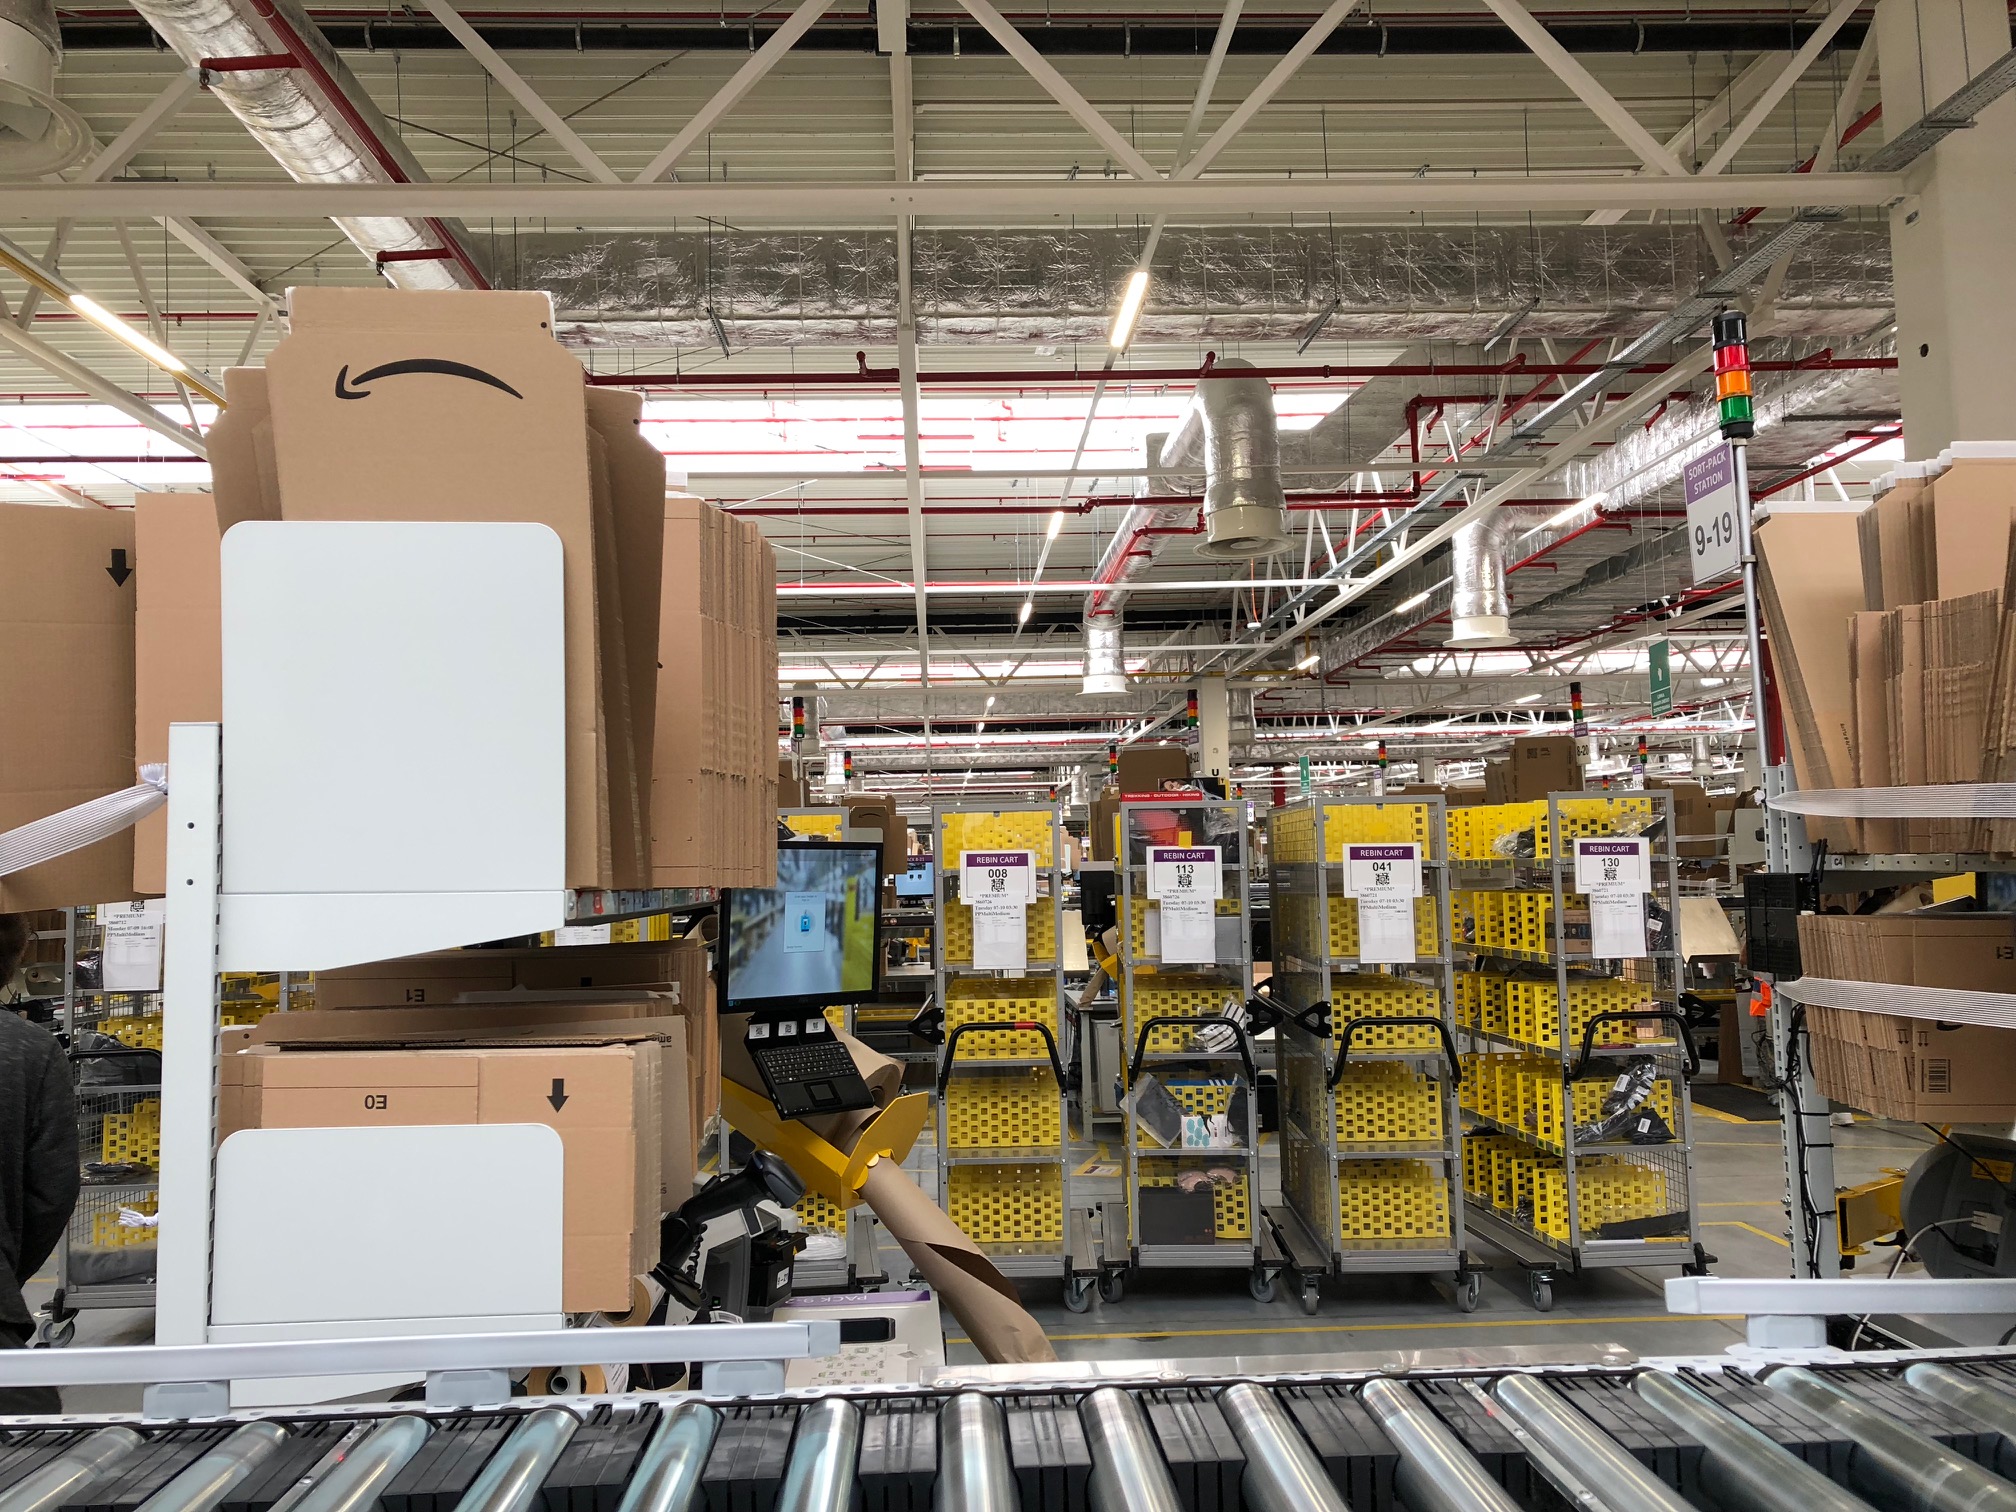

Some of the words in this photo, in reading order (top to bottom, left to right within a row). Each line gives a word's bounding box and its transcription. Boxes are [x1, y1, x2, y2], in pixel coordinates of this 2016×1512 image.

[1688, 450, 1727, 480] SORT-PACK
[1694, 470, 1723, 495] STATION
[1695, 512, 1732, 556] 9-19
[1212, 768, 1220, 776] U
[1372, 862, 1392, 871] 041
[1602, 858, 1619, 867] 130
[988, 868, 1008, 878] 008
[1176, 864, 1194, 874] 113
[1996, 946, 2014, 960] E1
[406, 989, 425, 1002] E1
[821, 1294, 868, 1303] PACK
